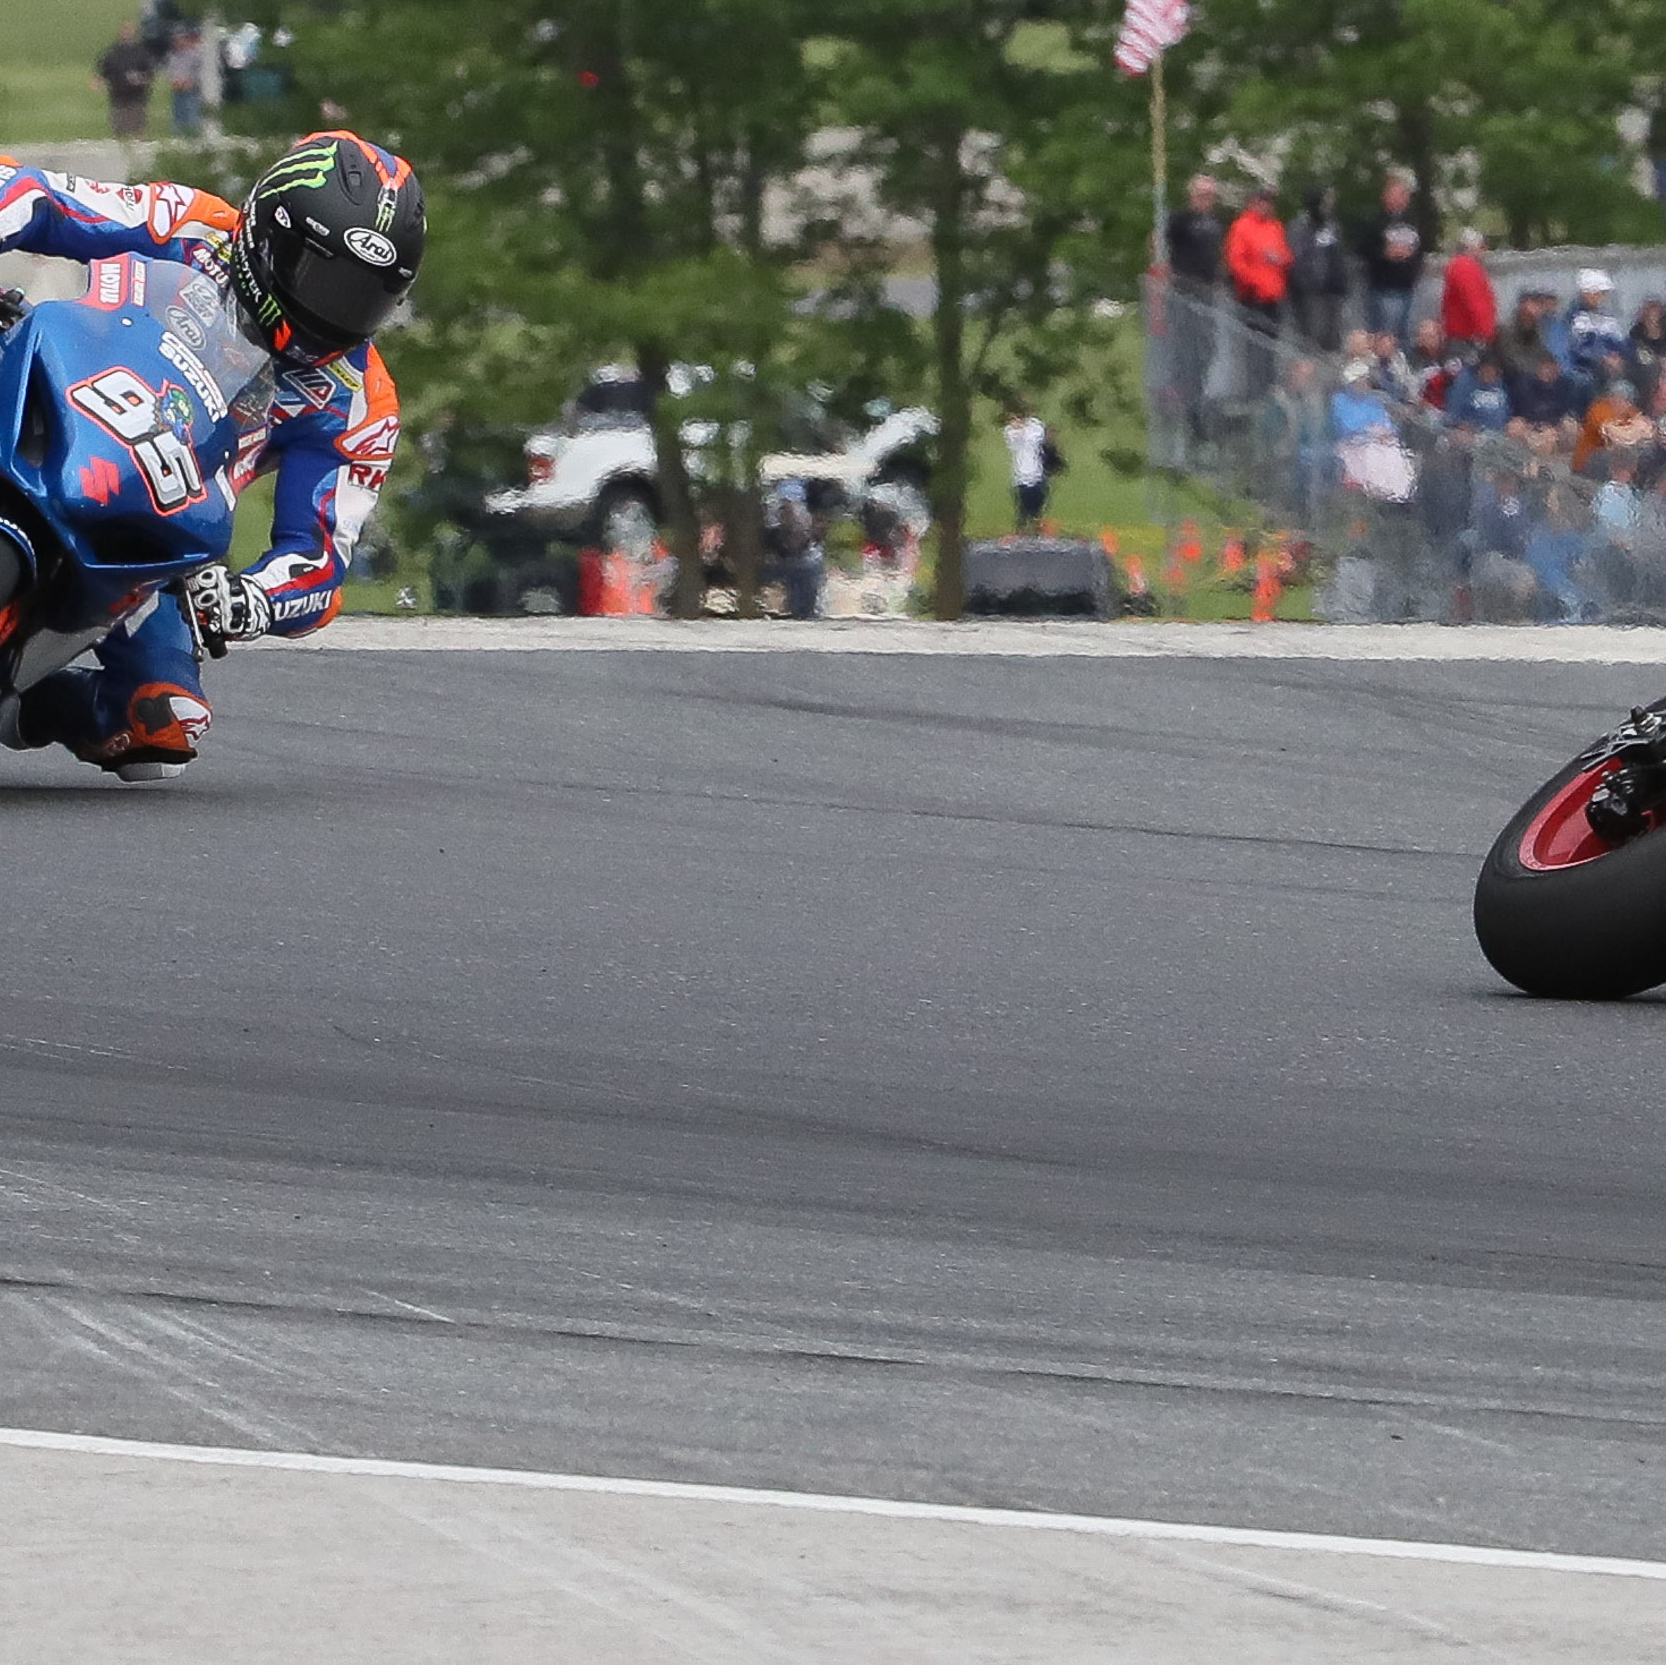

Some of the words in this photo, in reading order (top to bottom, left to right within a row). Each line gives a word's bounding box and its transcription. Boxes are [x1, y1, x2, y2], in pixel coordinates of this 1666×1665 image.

[349, 232, 392, 261] Arai
[158, 342, 220, 423] SUZUKI
[70, 369, 203, 509] 95
